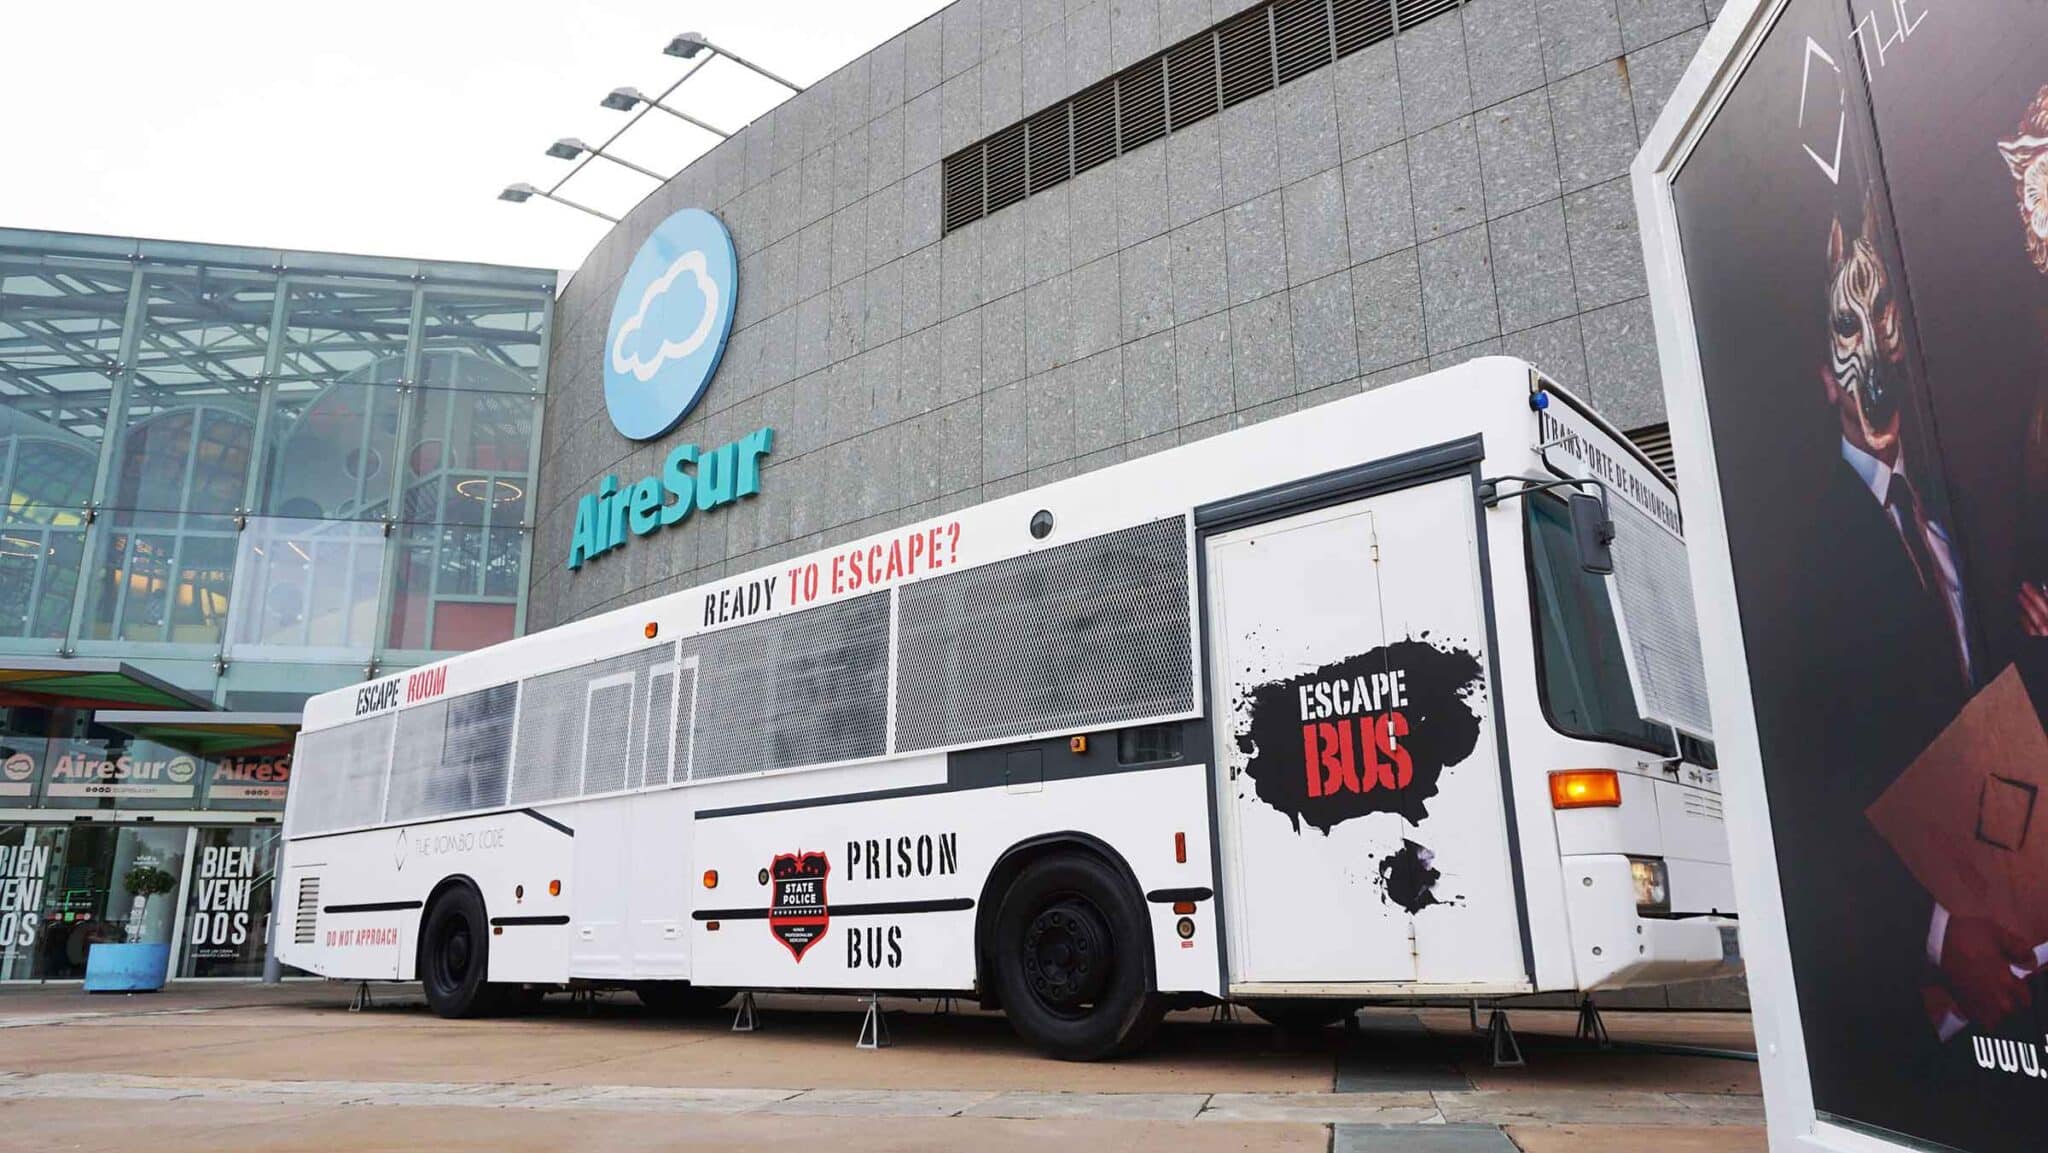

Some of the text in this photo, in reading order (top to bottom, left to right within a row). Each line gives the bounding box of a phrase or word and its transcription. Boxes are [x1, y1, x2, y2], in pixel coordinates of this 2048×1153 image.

[568, 426, 774, 571] AireSur
[1615, 463, 1628, 493] DE
[1629, 474, 1679, 534] PRISIONEROS
[704, 521, 962, 627] READY TO ESCAPE?
[355, 665, 448, 717] ESCAPE ROOM
[1299, 669, 1408, 721] ESCAPE
[51, 754, 166, 780] AireSur
[213, 757, 289, 782] AireS
[1303, 711, 1414, 798] BUS
[201, 846, 256, 878] BIEN
[847, 832, 958, 881] PRISON
[0, 879, 43, 911] ENI
[198, 879, 252, 911] VENI
[783, 894, 816, 905] POLICE
[785, 882, 814, 894] STATE
[0, 912, 38, 946] OS
[191, 912, 249, 945] DOS
[326, 927, 397, 947] DO NOT APPROACH
[847, 925, 902, 969] BUS
[1972, 1033, 2048, 1080] www.
